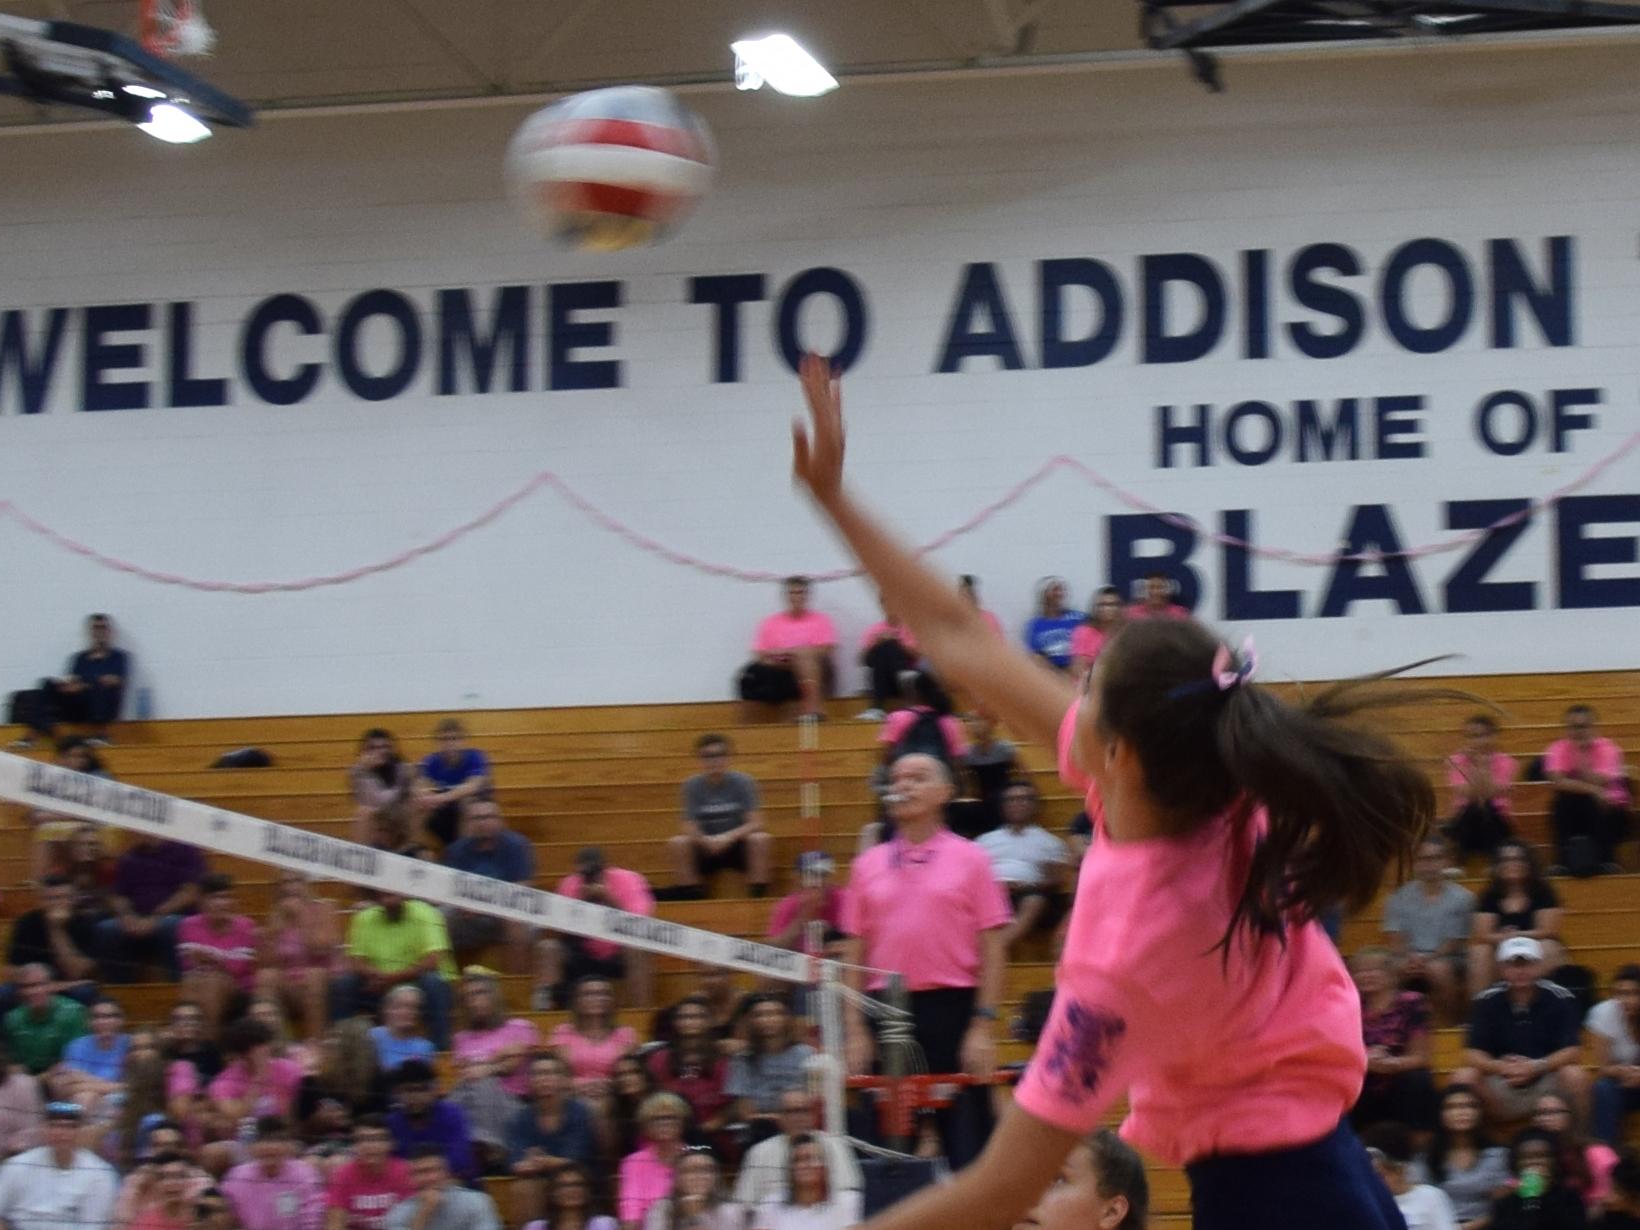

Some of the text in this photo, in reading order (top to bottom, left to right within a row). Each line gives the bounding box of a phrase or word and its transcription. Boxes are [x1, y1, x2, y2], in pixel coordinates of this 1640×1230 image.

[685, 266, 869, 386] TO
[935, 236, 1573, 374] ADDISON
[1158, 394, 1425, 468] HOME
[1476, 388, 1602, 456] OF
